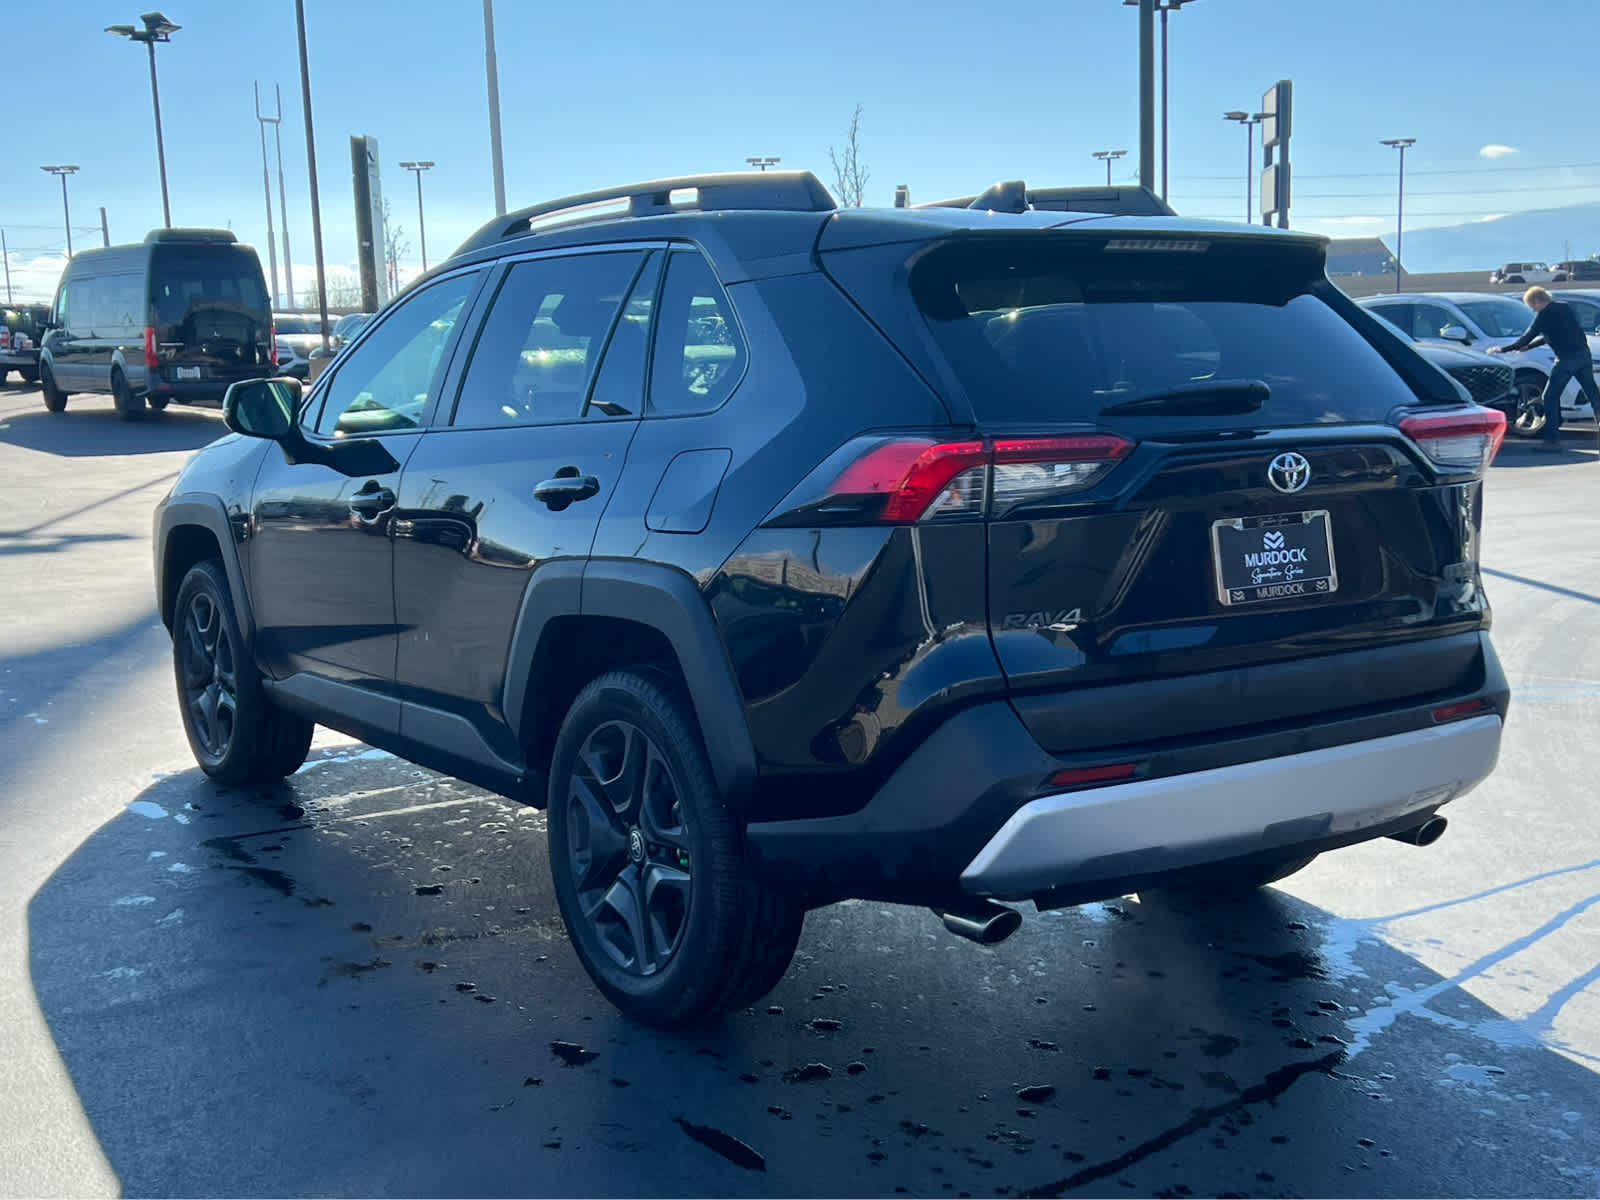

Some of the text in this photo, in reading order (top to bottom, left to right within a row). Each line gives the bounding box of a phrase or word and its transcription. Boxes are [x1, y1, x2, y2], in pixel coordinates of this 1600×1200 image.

[1244, 547, 1307, 568] MURDOCK
[1256, 583, 1304, 599] MURDOCK
[1002, 607, 1081, 631] RAV4
